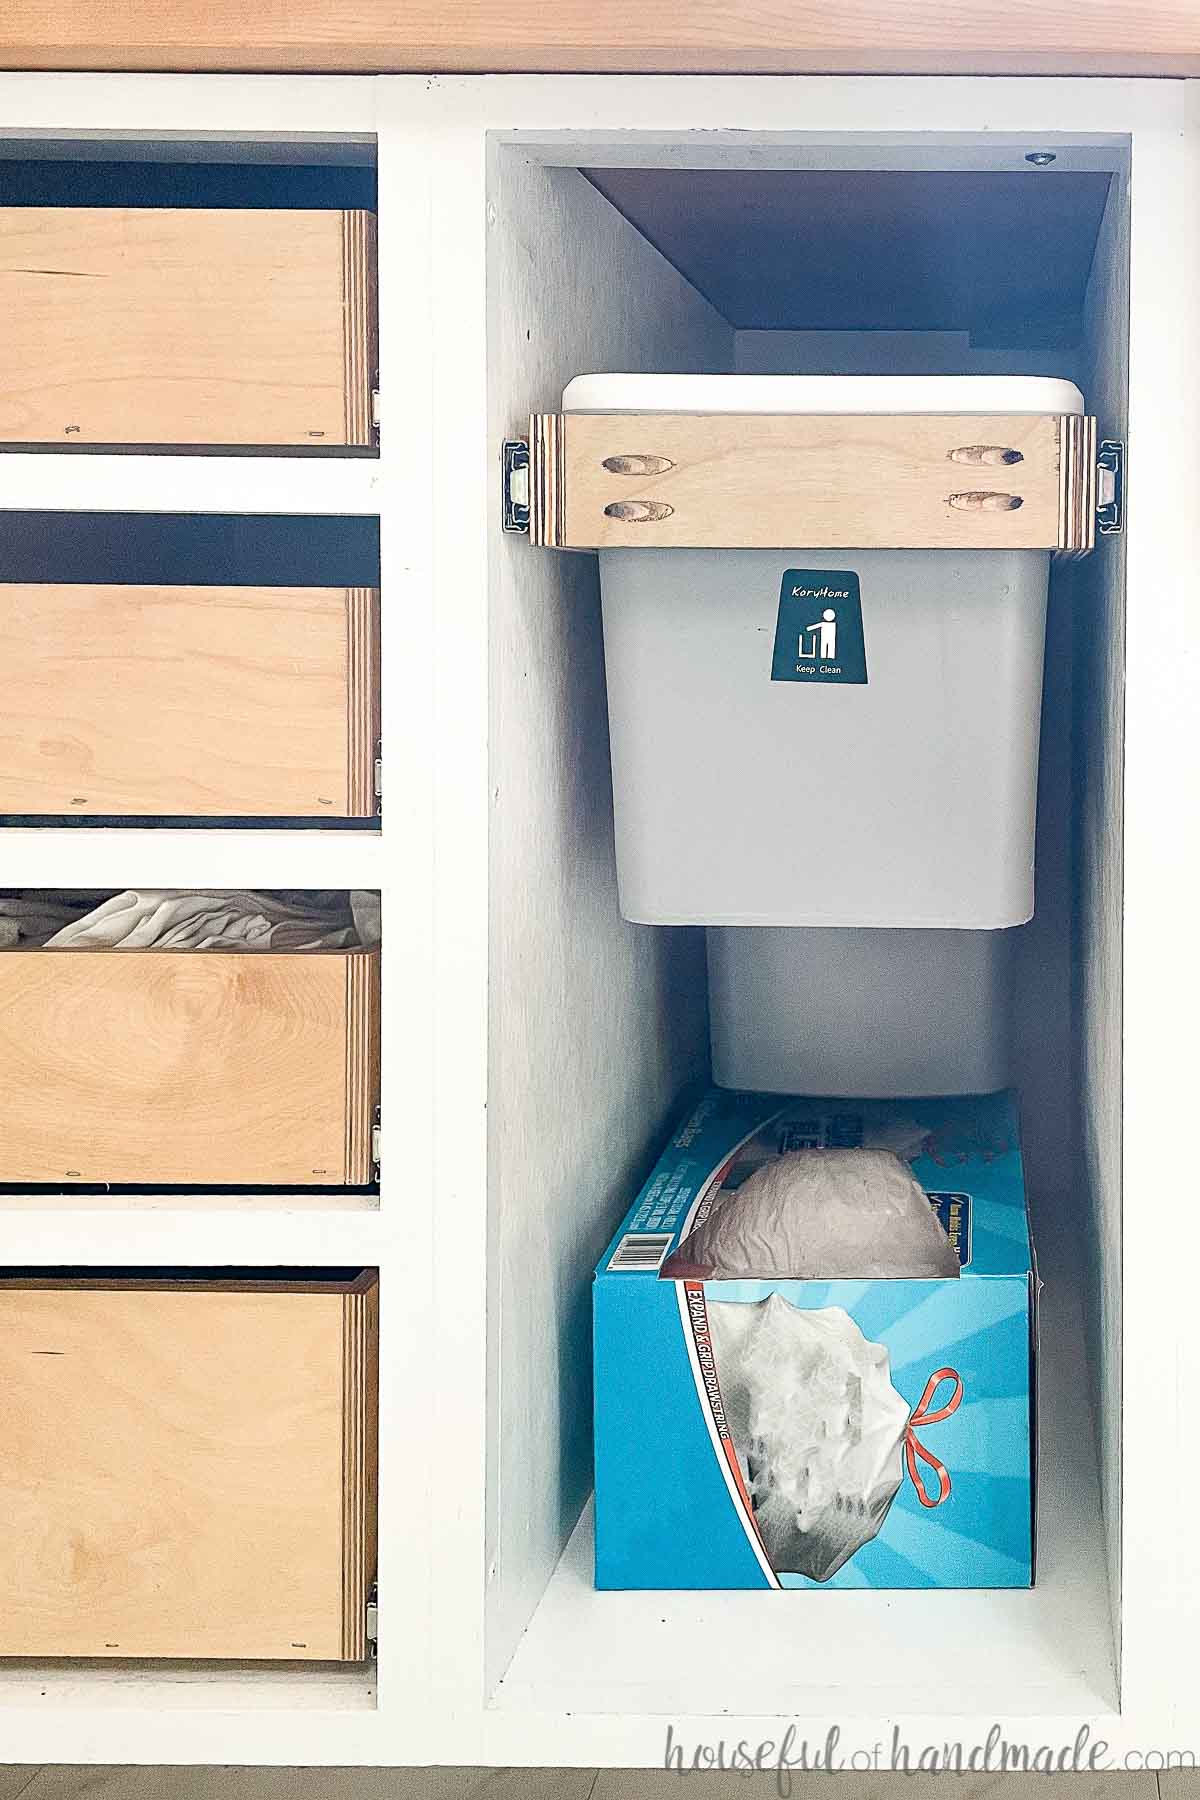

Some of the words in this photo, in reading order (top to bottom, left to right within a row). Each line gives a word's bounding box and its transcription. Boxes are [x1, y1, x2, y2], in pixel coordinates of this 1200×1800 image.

[791, 586, 849, 599] KoryHome
[796, 664, 816, 675] Keep
[819, 664, 841, 674] Clean
[687, 1290, 710, 1334] EXPAND
[695, 1335, 710, 1344] &
[697, 1344, 714, 1369] GRIP
[703, 1370, 730, 1440] DRAWSTRING
